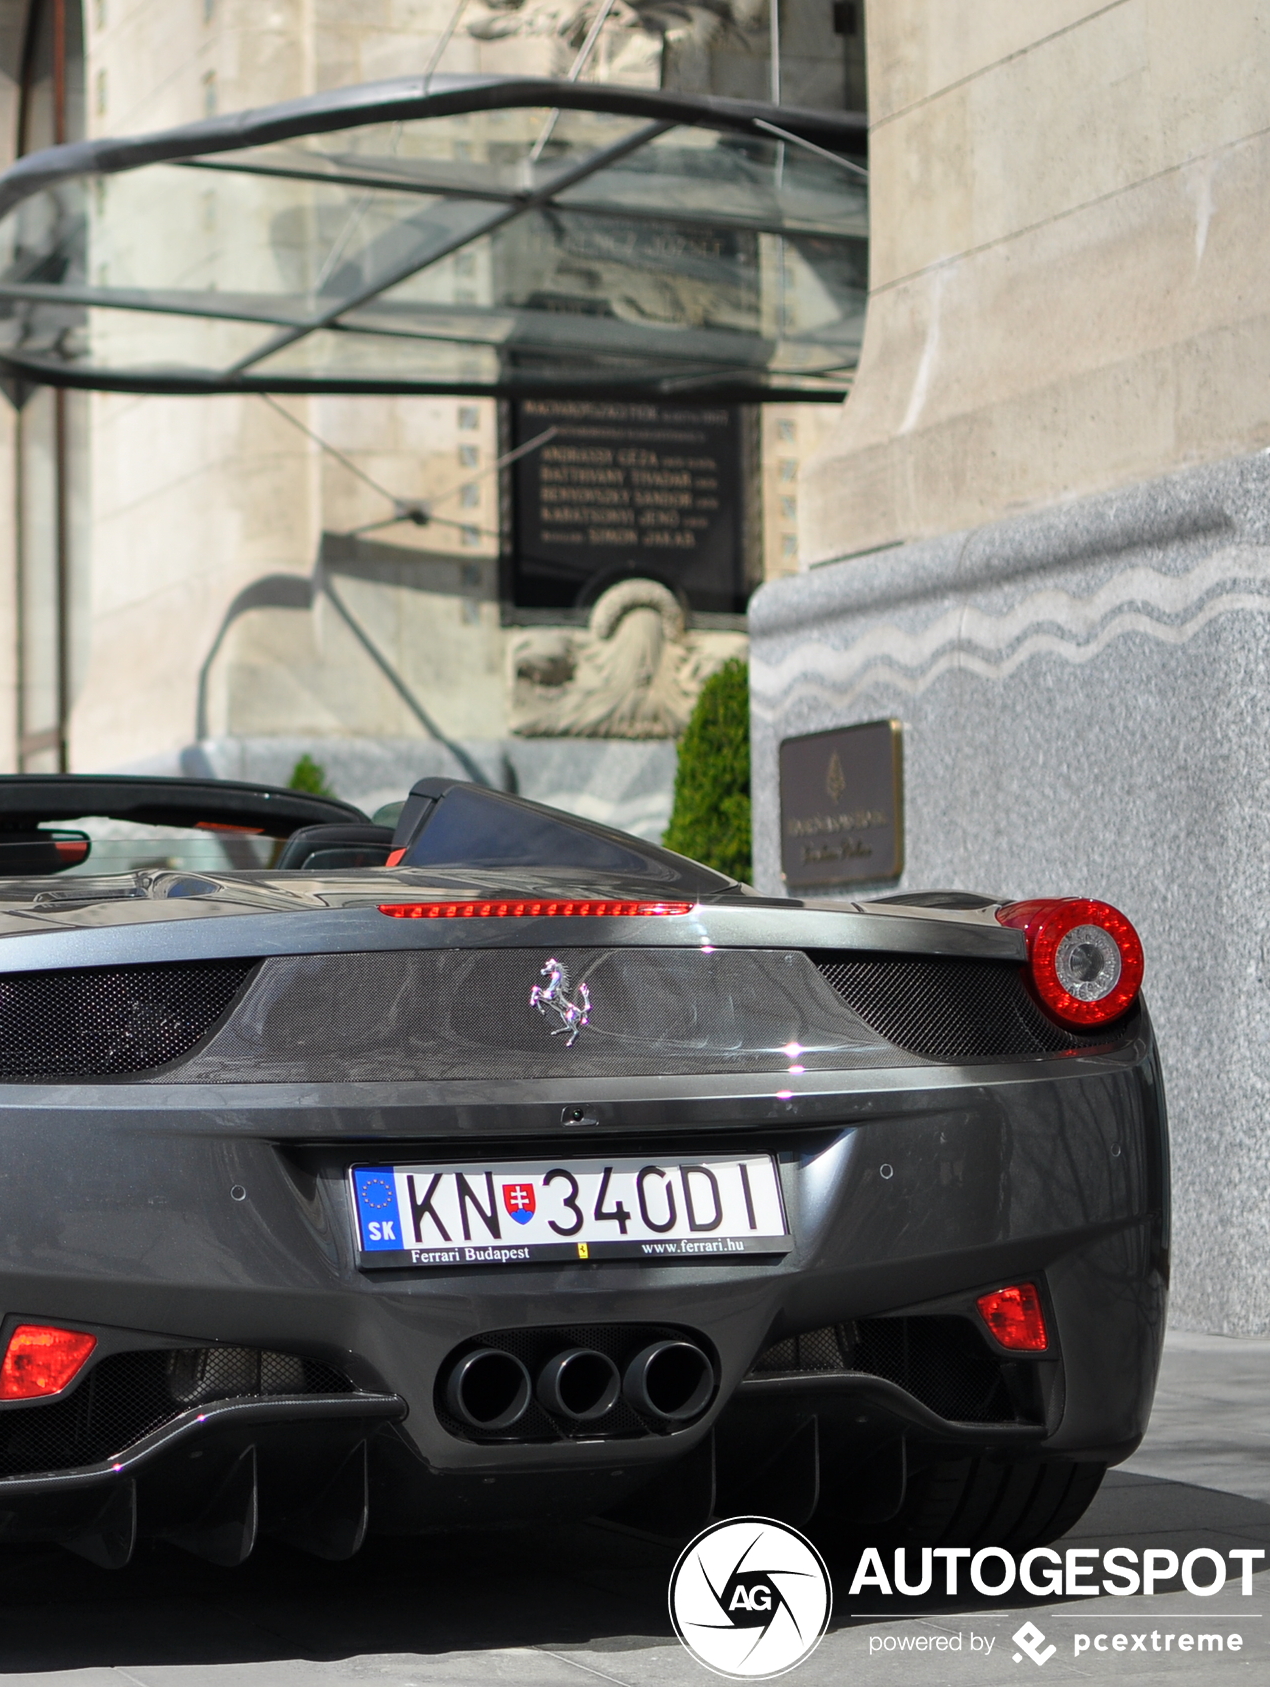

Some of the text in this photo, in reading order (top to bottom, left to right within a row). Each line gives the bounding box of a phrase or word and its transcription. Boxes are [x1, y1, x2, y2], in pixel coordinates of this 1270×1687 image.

[406, 1170, 502, 1243] KN
[368, 1220, 396, 1241] SK
[411, 1246, 530, 1263] Ferrari Budapest
[642, 1238, 744, 1254] www.ferrari.hu
